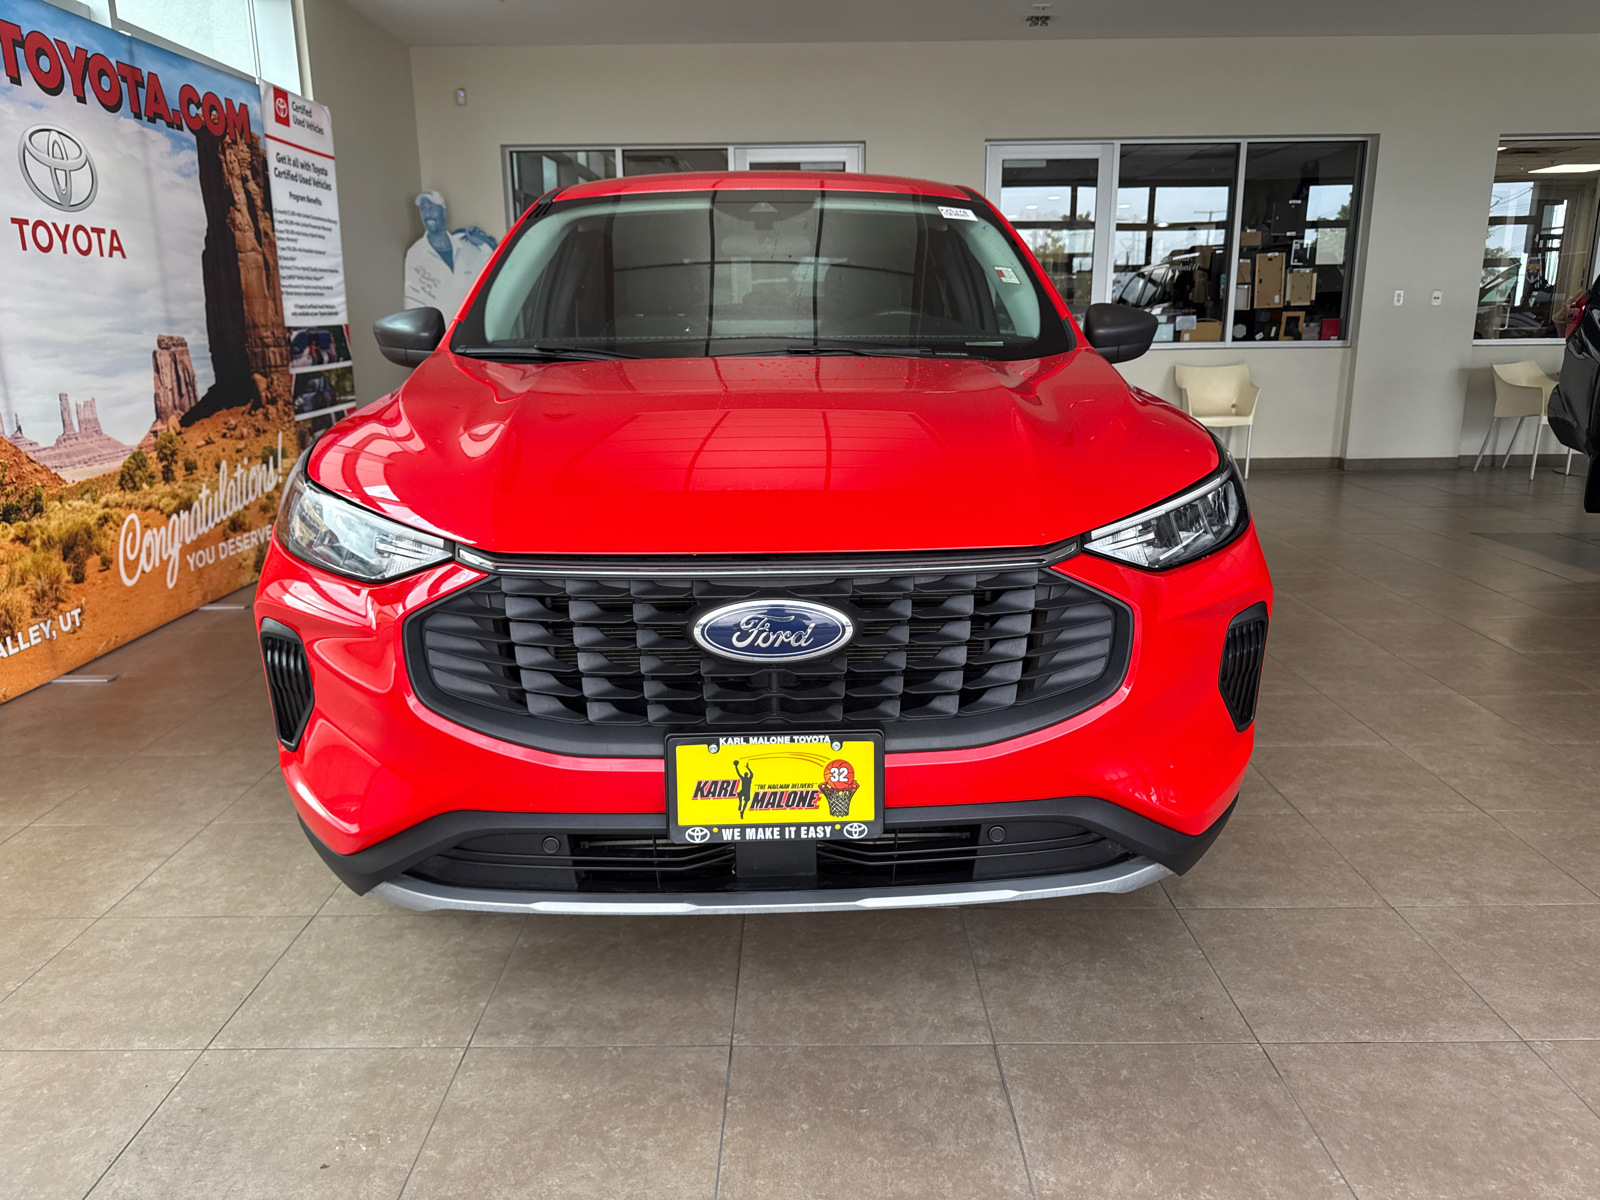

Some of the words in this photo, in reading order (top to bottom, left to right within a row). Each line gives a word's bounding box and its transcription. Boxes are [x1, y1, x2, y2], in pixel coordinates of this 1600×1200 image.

[0, 19, 251, 144] TOYOTA.COM
[292, 101, 313, 118] Certified
[292, 114, 305, 128] Used
[306, 120, 324, 136] Vehicles
[276, 152, 286, 165] Get
[286, 154, 292, 167] it
[300, 159, 311, 172] with
[311, 162, 328, 177] Toyota
[274, 167, 298, 183] Certified
[299, 172, 311, 186] Used
[312, 176, 332, 191] Vehicles
[289, 191, 306, 203] Program
[10, 217, 127, 259] TOYOTA
[118, 431, 282, 589] Congratulations!
[186, 545, 216, 572] YOU
[218, 523, 273, 560] DESERVE
[58, 607, 82, 632] UT
[731, 614, 816, 648] Ford
[719, 737, 748, 746] KARL
[749, 736, 791, 745] MALONE
[793, 735, 830, 744] TOYOTA
[829, 767, 848, 783] 32
[692, 779, 741, 800] KARL
[749, 789, 821, 811] MALONE
[722, 828, 741, 841] WE
[745, 827, 780, 840] MAKE
[785, 827, 796, 839] IT
[800, 825, 832, 839] EASY
